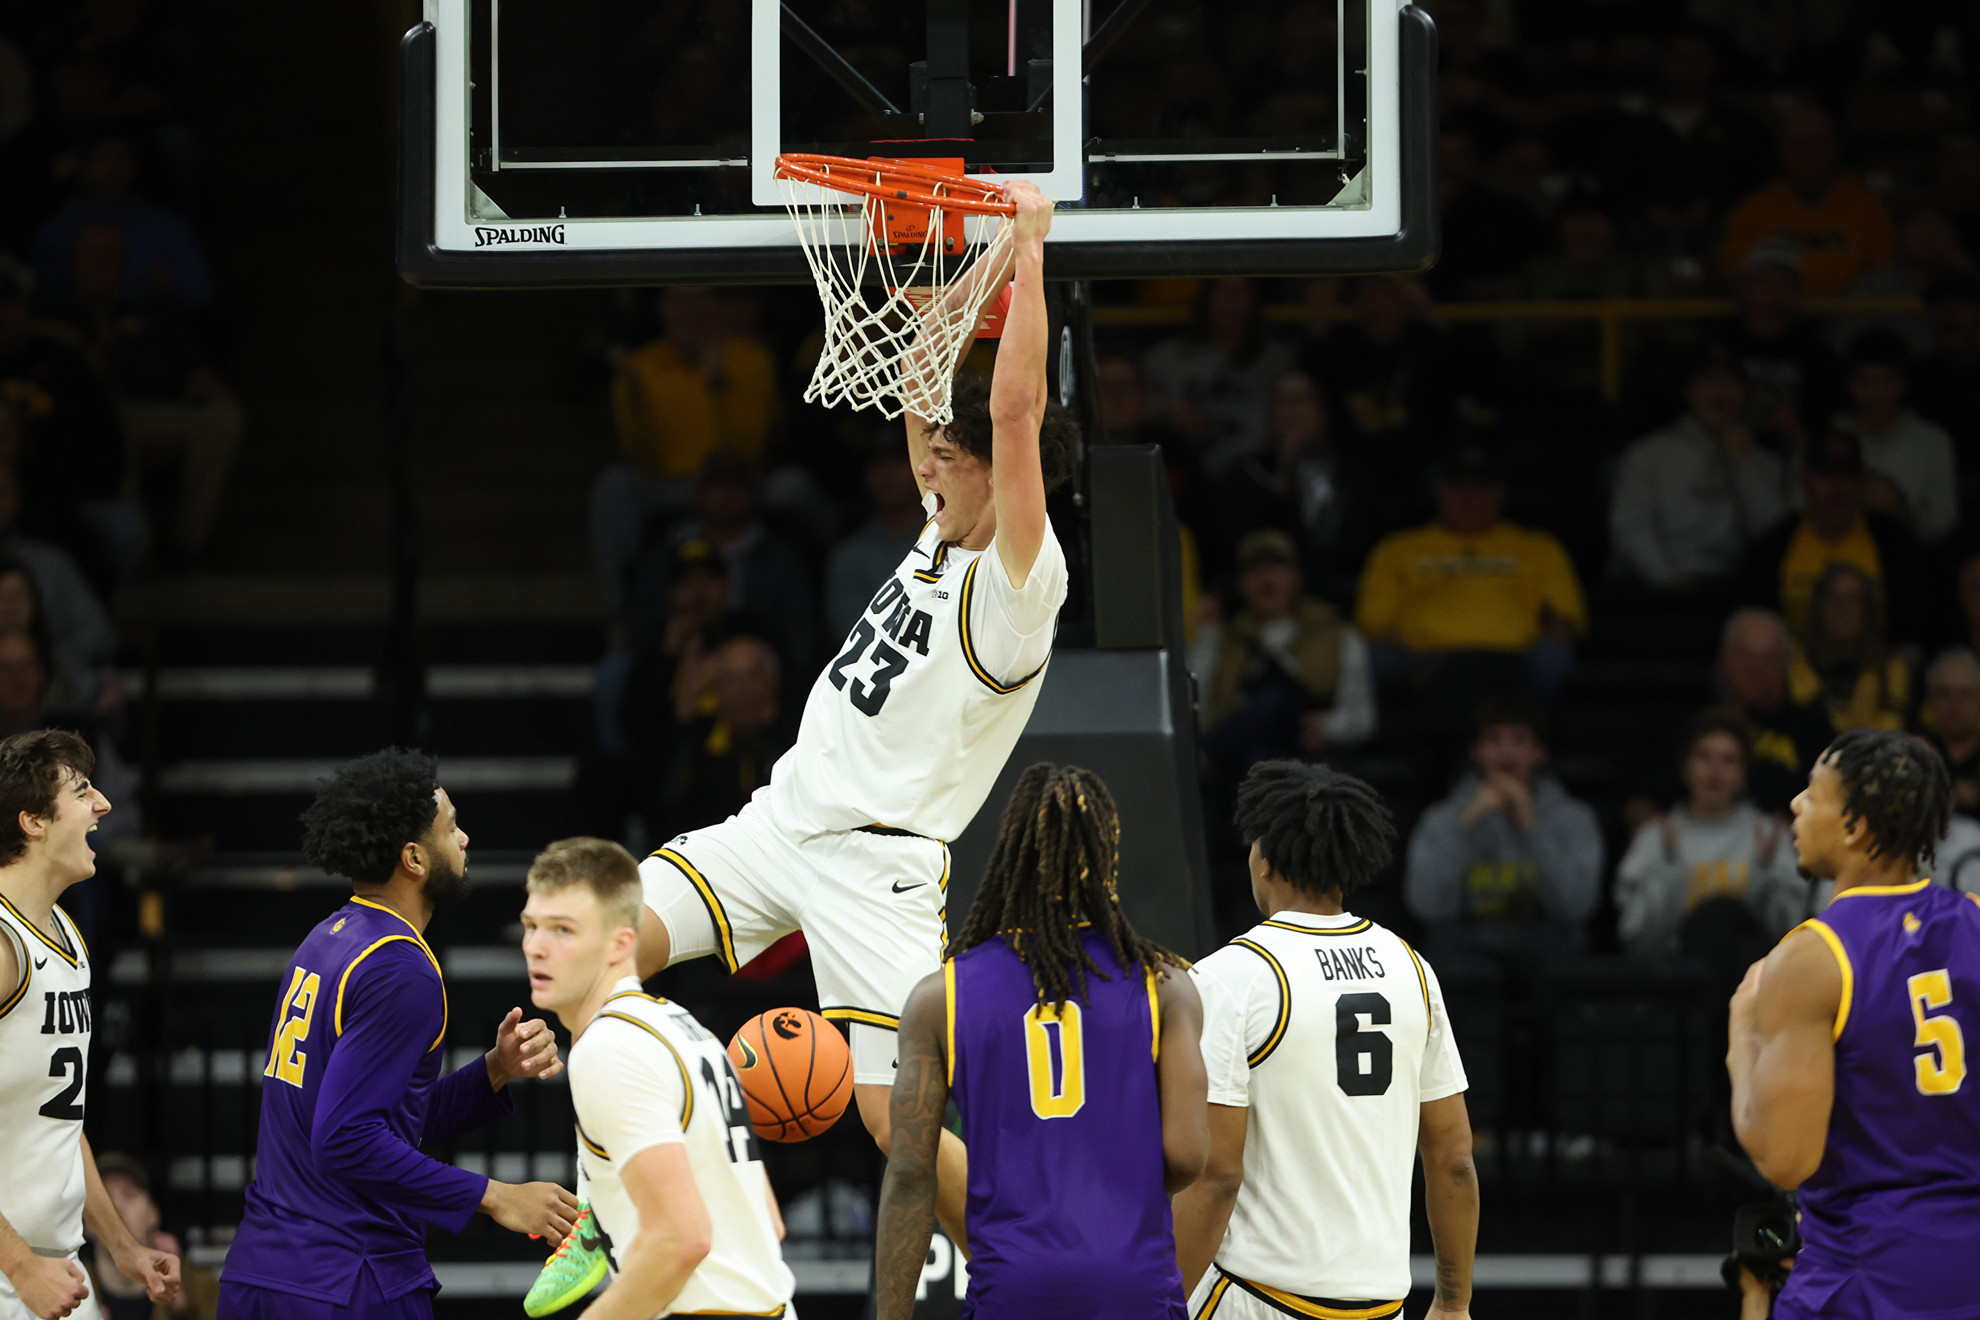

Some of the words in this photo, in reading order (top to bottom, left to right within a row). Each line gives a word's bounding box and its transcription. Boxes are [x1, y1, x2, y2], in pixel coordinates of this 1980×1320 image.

[475, 224, 565, 247] SPALDING
[870, 571, 933, 657] OWA
[828, 617, 910, 717] 23
[1314, 946, 1386, 981] BANKS
[41, 988, 92, 1034] IOW
[264, 966, 321, 1089] 12
[1335, 992, 1393, 1096] 6
[1907, 968, 1968, 1096] 5
[39, 1046, 84, 1120] 2
[1023, 1000, 1086, 1120] 0
